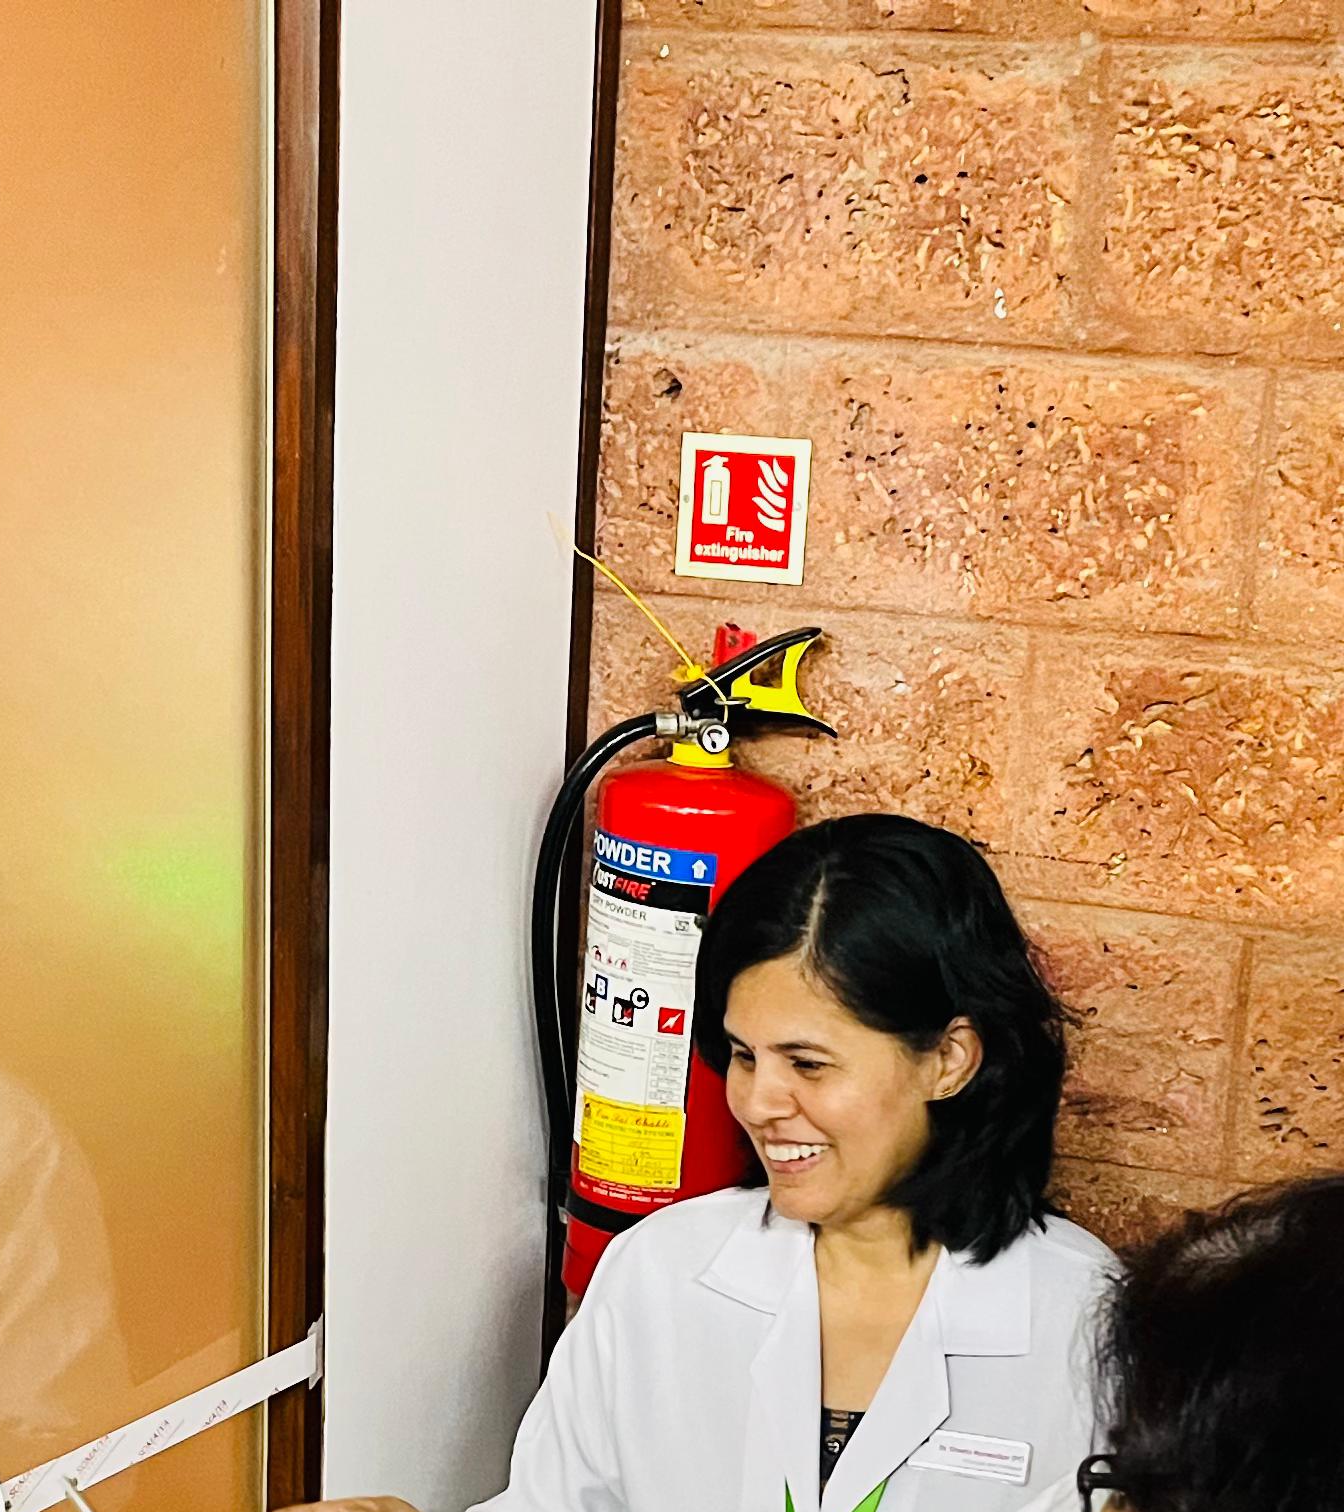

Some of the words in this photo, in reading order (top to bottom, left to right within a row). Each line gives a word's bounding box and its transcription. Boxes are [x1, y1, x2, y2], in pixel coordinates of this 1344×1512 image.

[725, 525, 755, 543] Fire
[694, 541, 785, 563] extinguisher
[605, 900, 648, 921] POWDER
